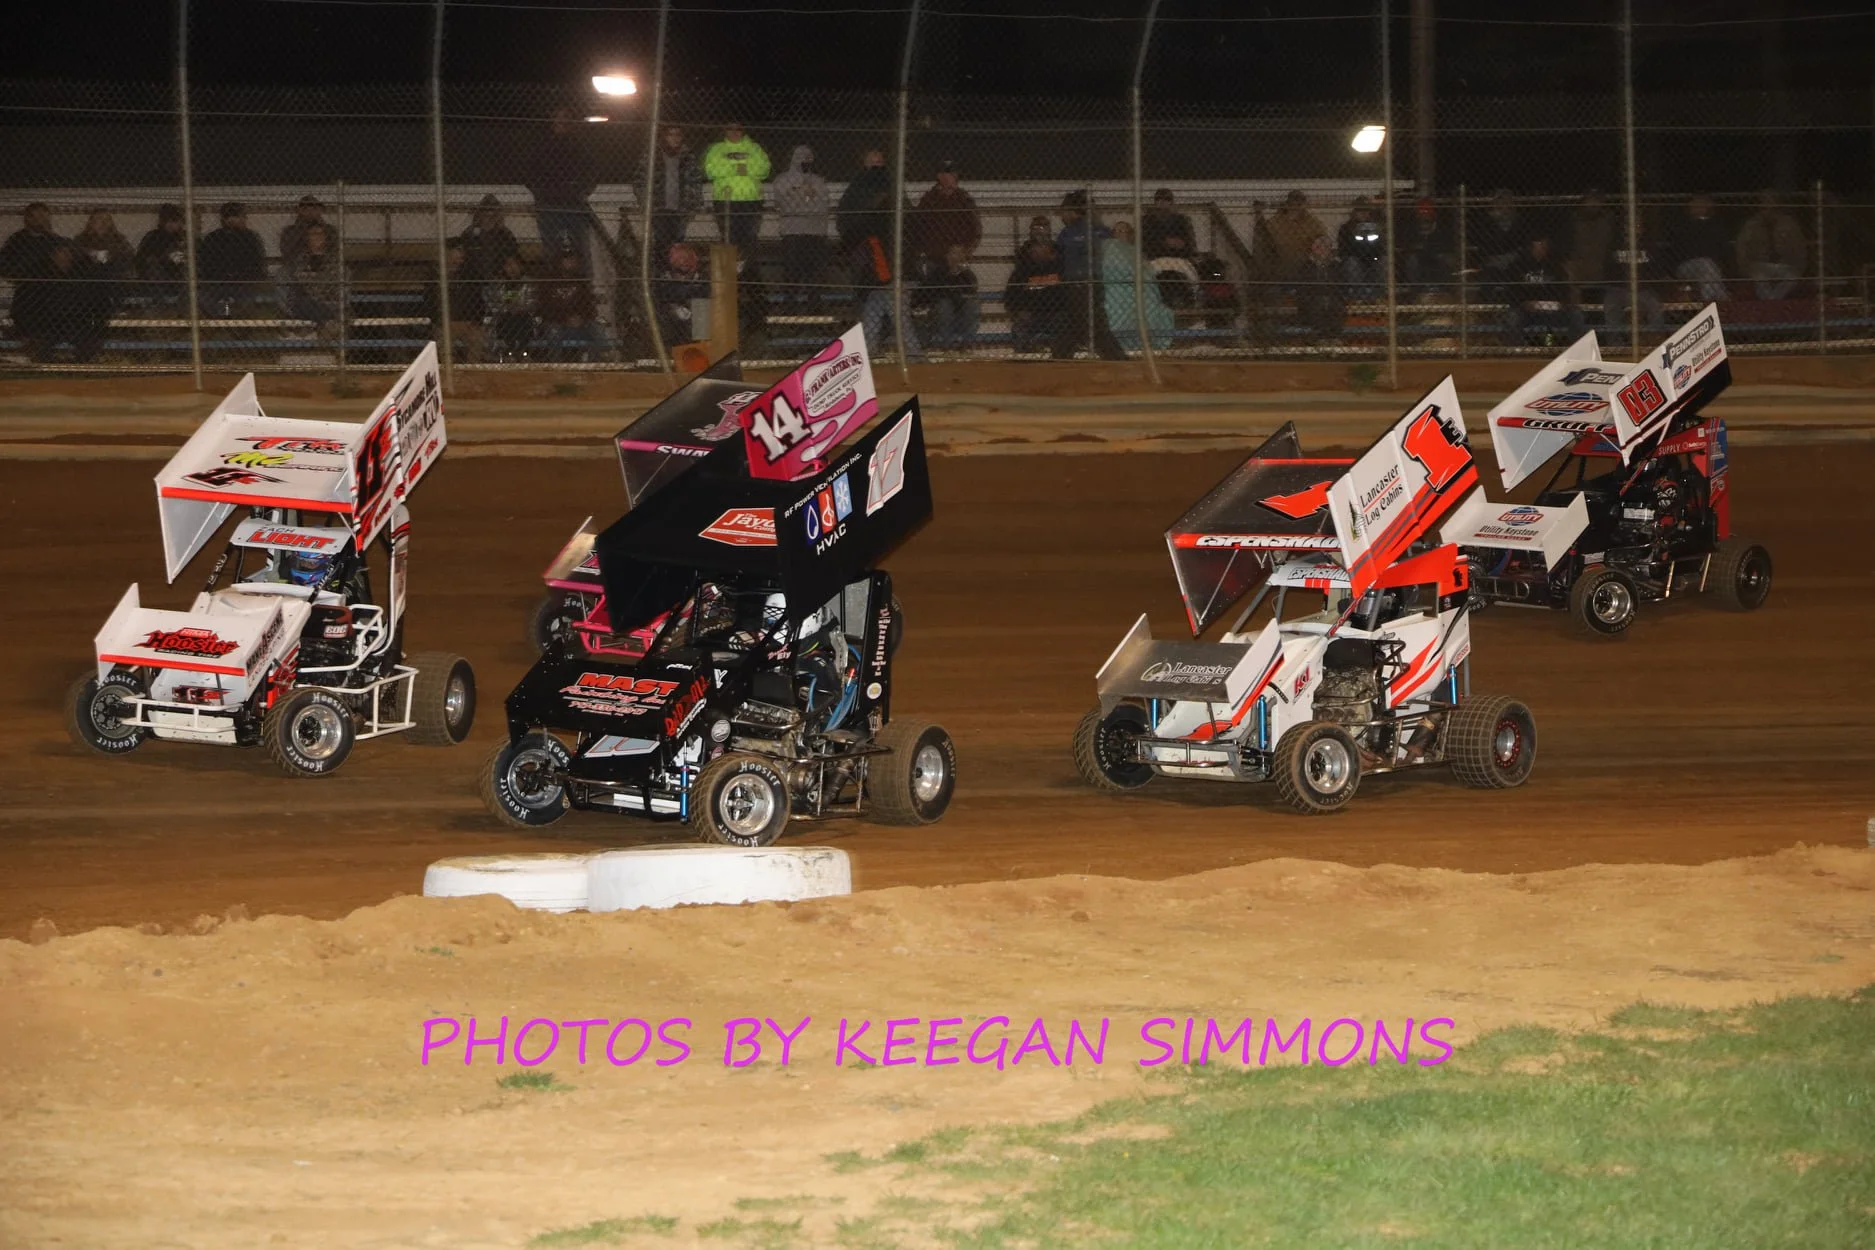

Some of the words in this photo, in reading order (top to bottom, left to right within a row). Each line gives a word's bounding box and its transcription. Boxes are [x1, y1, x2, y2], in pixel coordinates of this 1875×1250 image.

[1617, 369, 1667, 426] 03
[748, 389, 813, 464] 14
[794, 490, 815, 511] POWER
[849, 452, 862, 465] INC.
[1360, 464, 1399, 508] Lancaster
[1365, 507, 1381, 526] Log
[1380, 484, 1404, 511] Cabins
[816, 523, 848, 555] HVAC
[1172, 662, 1233, 675] Lancaster
[1187, 675, 1222, 685] Cabis
[575, 672, 680, 697] MAST
[311, 692, 350, 718] Hoosier
[286, 745, 325, 772] Hoosier
[739, 761, 781, 786] Hoosier
[500, 777, 531, 820] Hoosier
[718, 823, 760, 848] Hoosier
